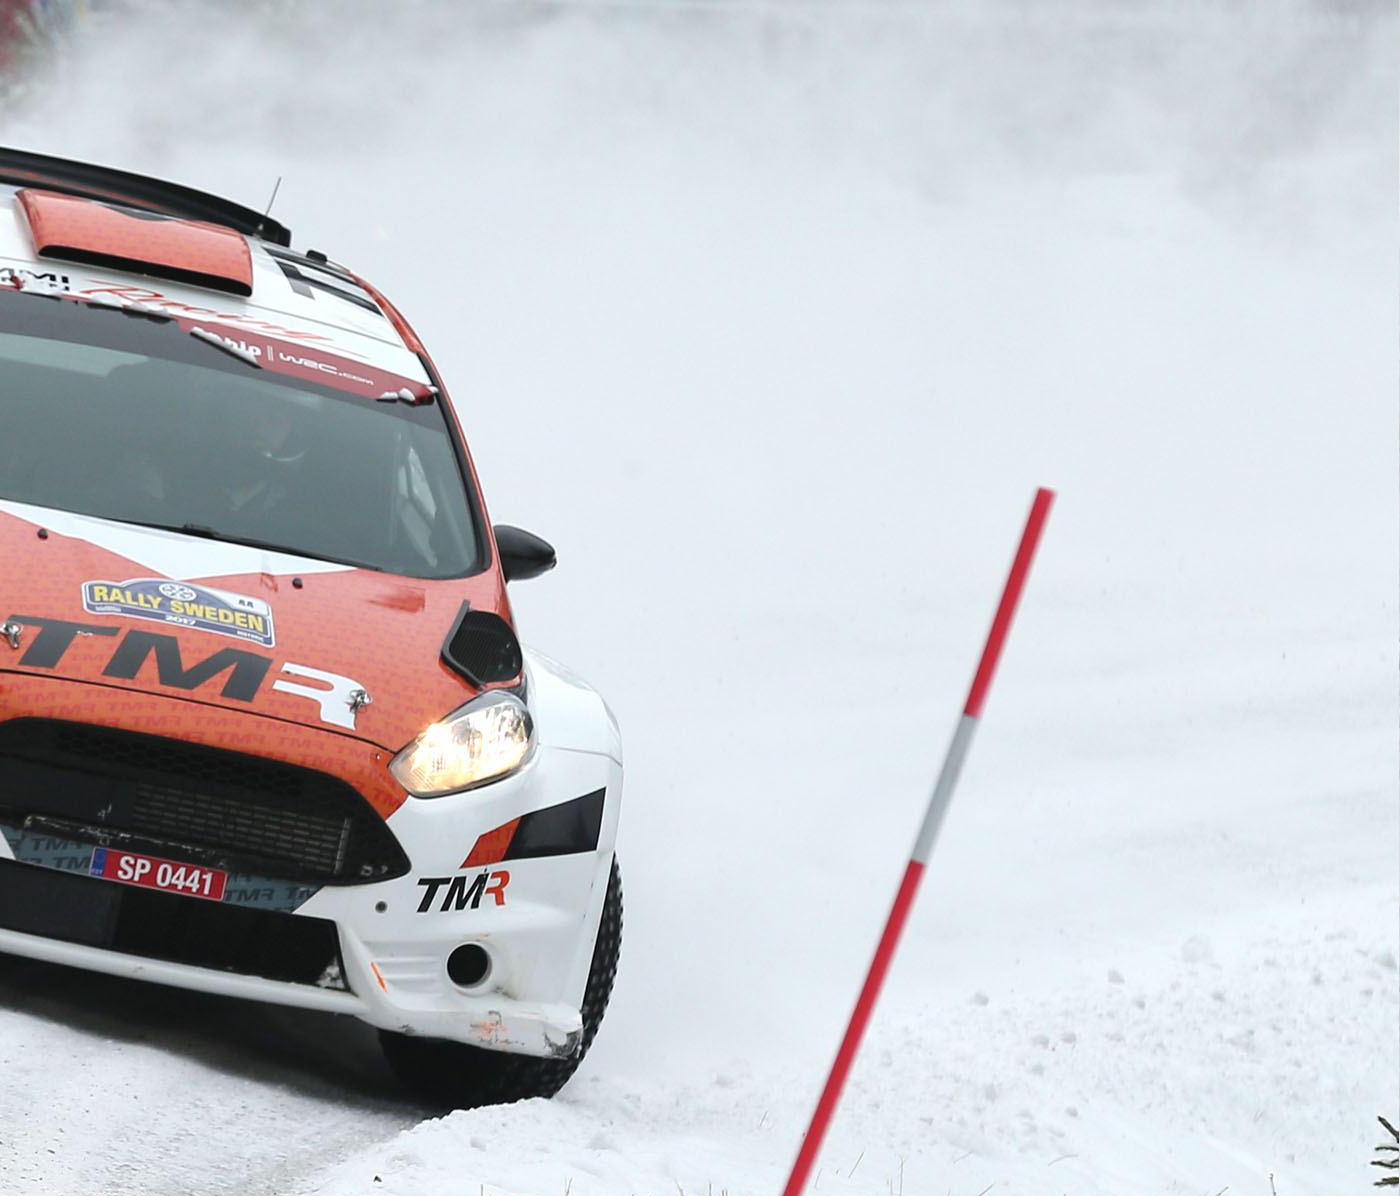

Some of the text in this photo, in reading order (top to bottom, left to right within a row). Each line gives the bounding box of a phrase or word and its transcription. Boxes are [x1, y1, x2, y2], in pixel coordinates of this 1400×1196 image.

[93, 585, 265, 633] RALLY SWEDEN
[165, 614, 197, 626] 2017
[4, 613, 364, 730] TMR
[117, 855, 215, 895] SP 0441
[416, 870, 511, 914] TMR
